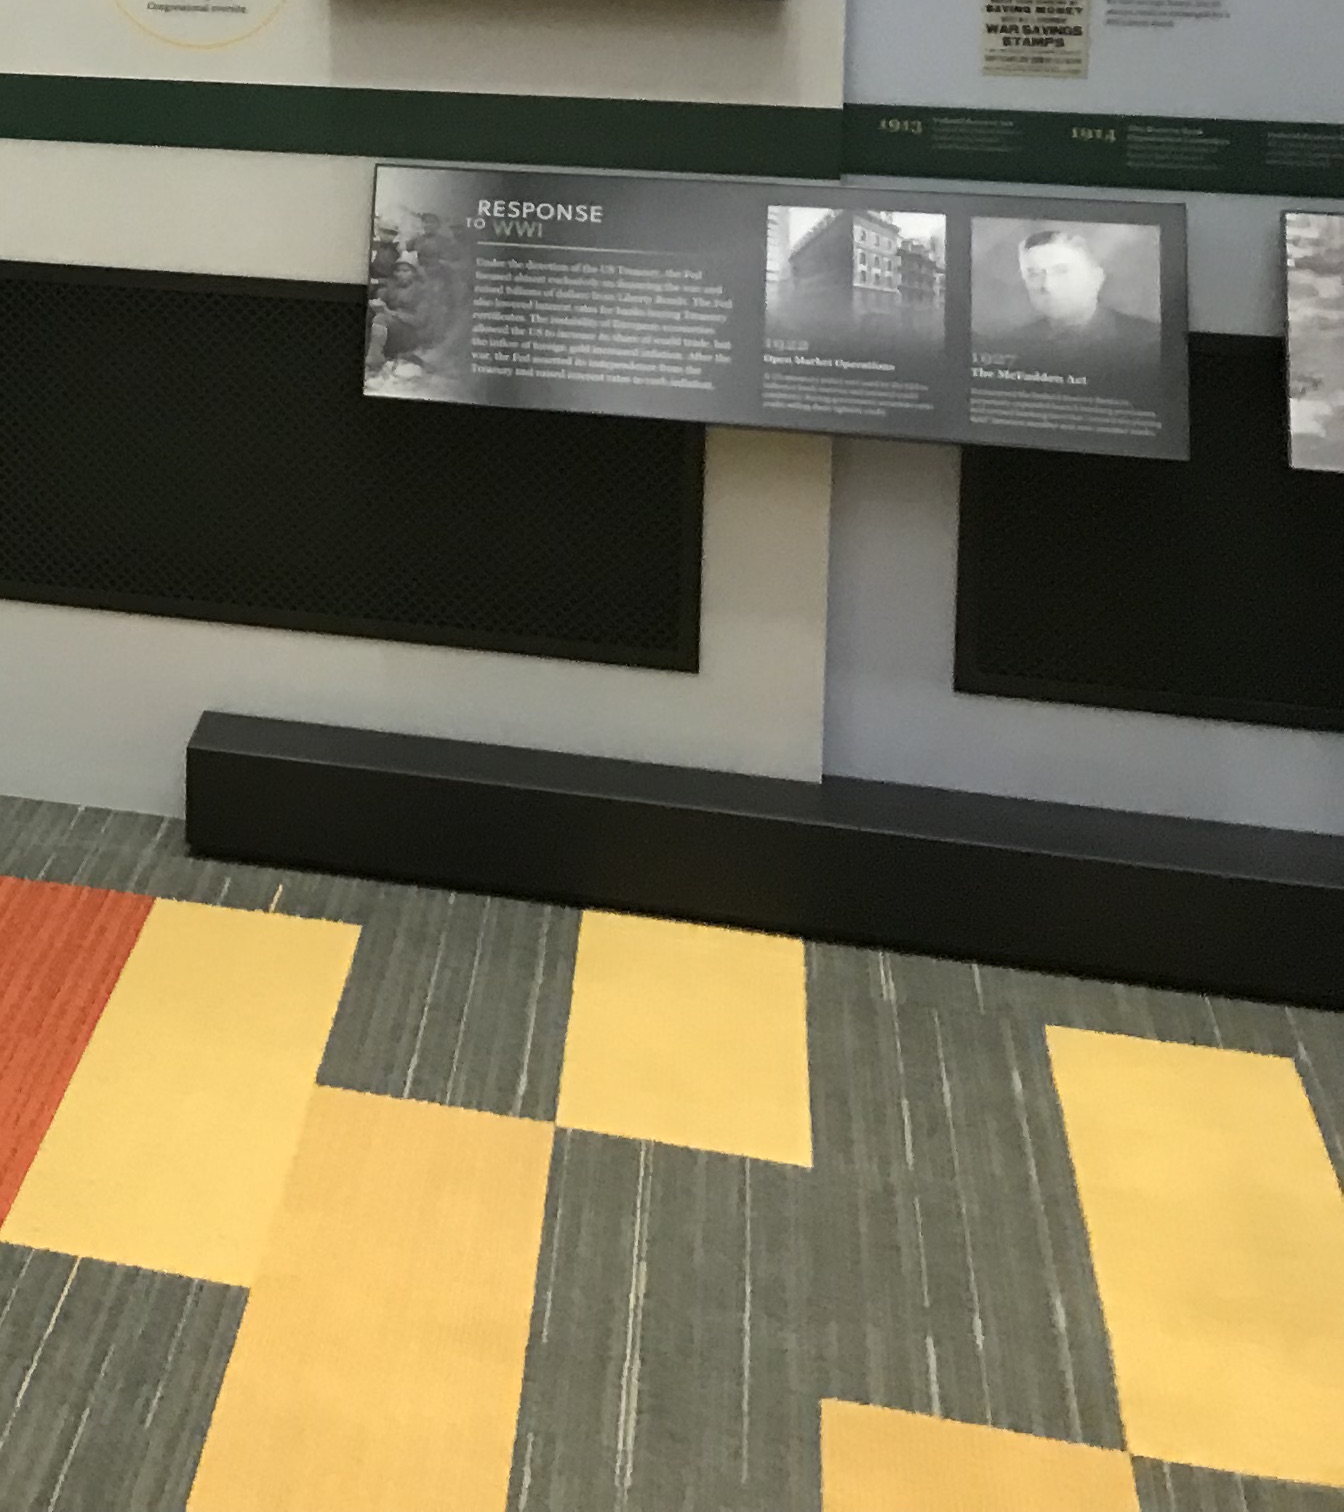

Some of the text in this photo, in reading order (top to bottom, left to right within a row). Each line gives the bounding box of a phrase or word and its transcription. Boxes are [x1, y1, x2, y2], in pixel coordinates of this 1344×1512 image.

[477, 199, 604, 223] RESPONSE
[466, 217, 543, 238] TO WWI
